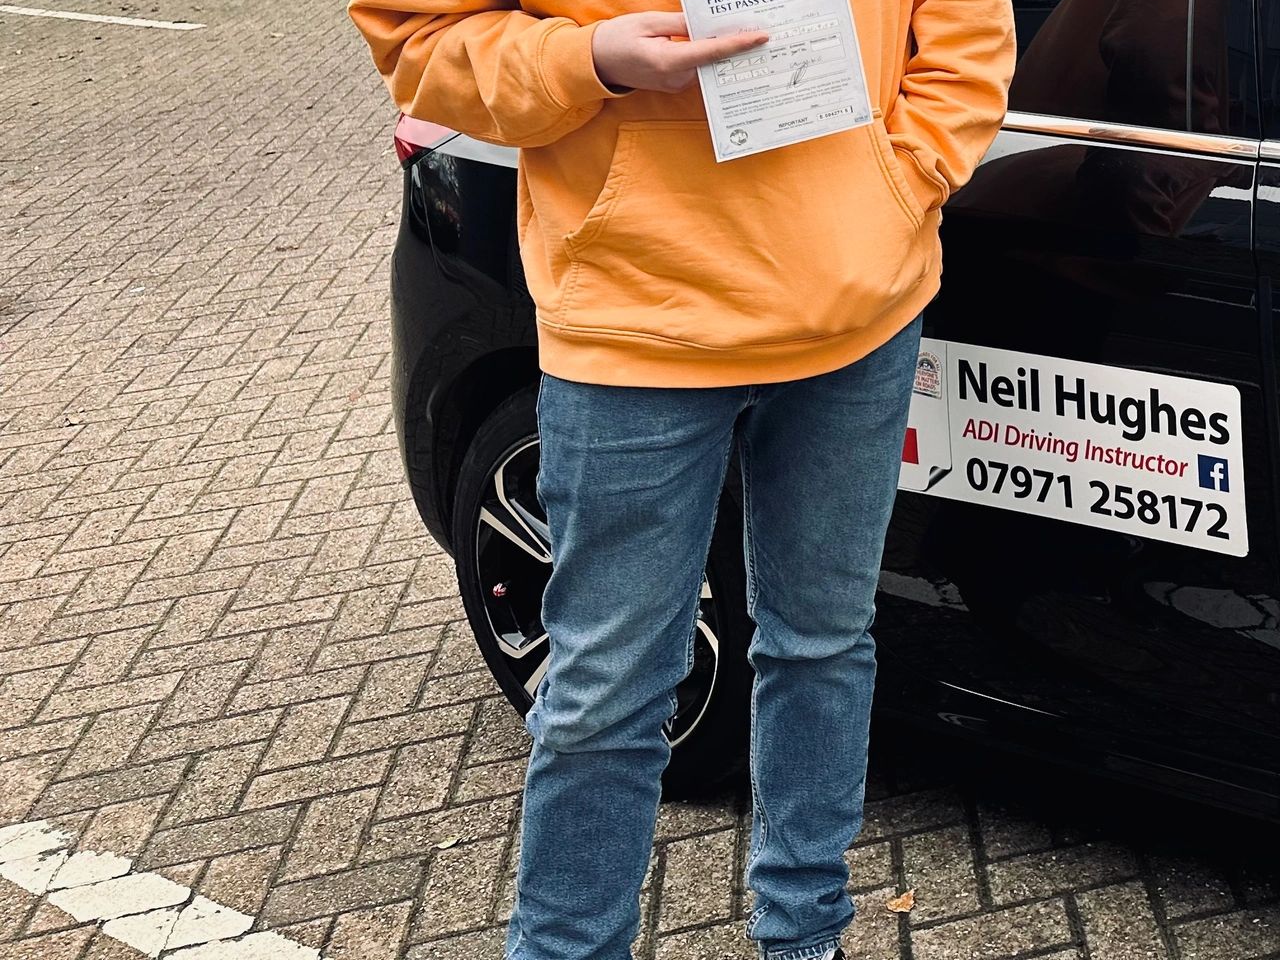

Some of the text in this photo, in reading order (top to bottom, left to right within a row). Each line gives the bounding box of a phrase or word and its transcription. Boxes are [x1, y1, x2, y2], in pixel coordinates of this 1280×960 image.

[709, 2, 733, 15] TEST
[958, 359, 1231, 446] Neil Hughes
[962, 418, 999, 444] ADI
[1004, 425, 1079, 463] Driving
[1084, 439, 1189, 478] Instructor
[966, 457, 1230, 541] 07971 258172
